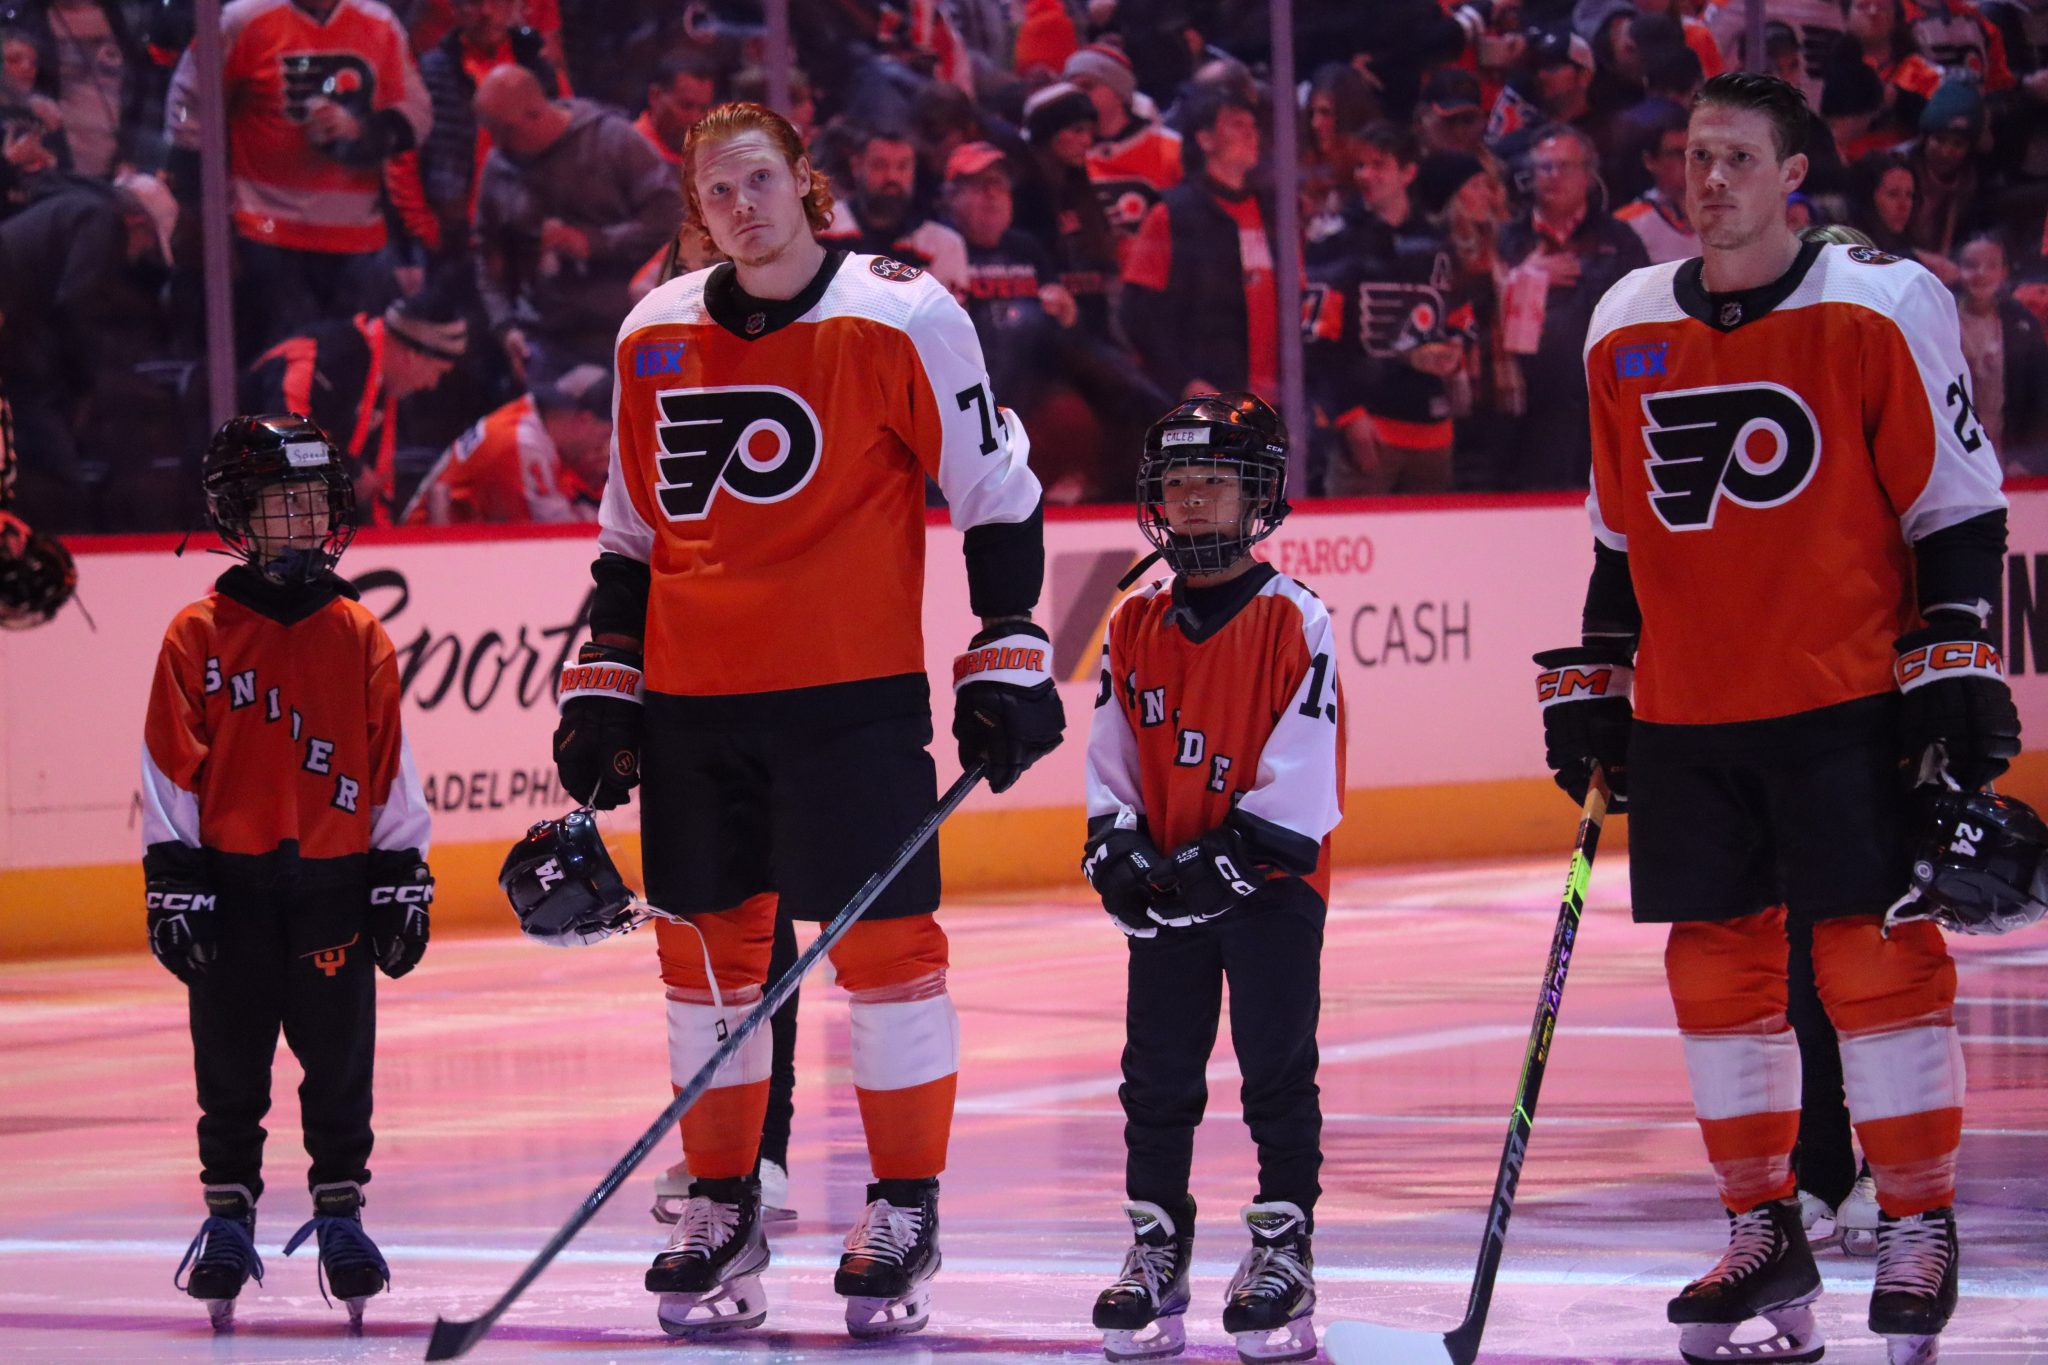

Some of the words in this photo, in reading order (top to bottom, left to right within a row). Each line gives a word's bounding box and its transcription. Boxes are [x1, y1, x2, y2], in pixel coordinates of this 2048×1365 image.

[636, 349, 685, 377] IBX
[1615, 350, 1667, 380] IBX
[1946, 374, 1990, 454] 2
[1165, 431, 1196, 442] CALEB
[1266, 443, 1283, 454] CCM
[1280, 533, 1374, 577] FARGO
[1351, 601, 1470, 667] CASH
[1898, 642, 2003, 686] CCM
[424, 768, 571, 812] ADELPHI
[1951, 822, 1984, 858] 24
[534, 857, 565, 892] 74
[146, 891, 217, 911] CCM
